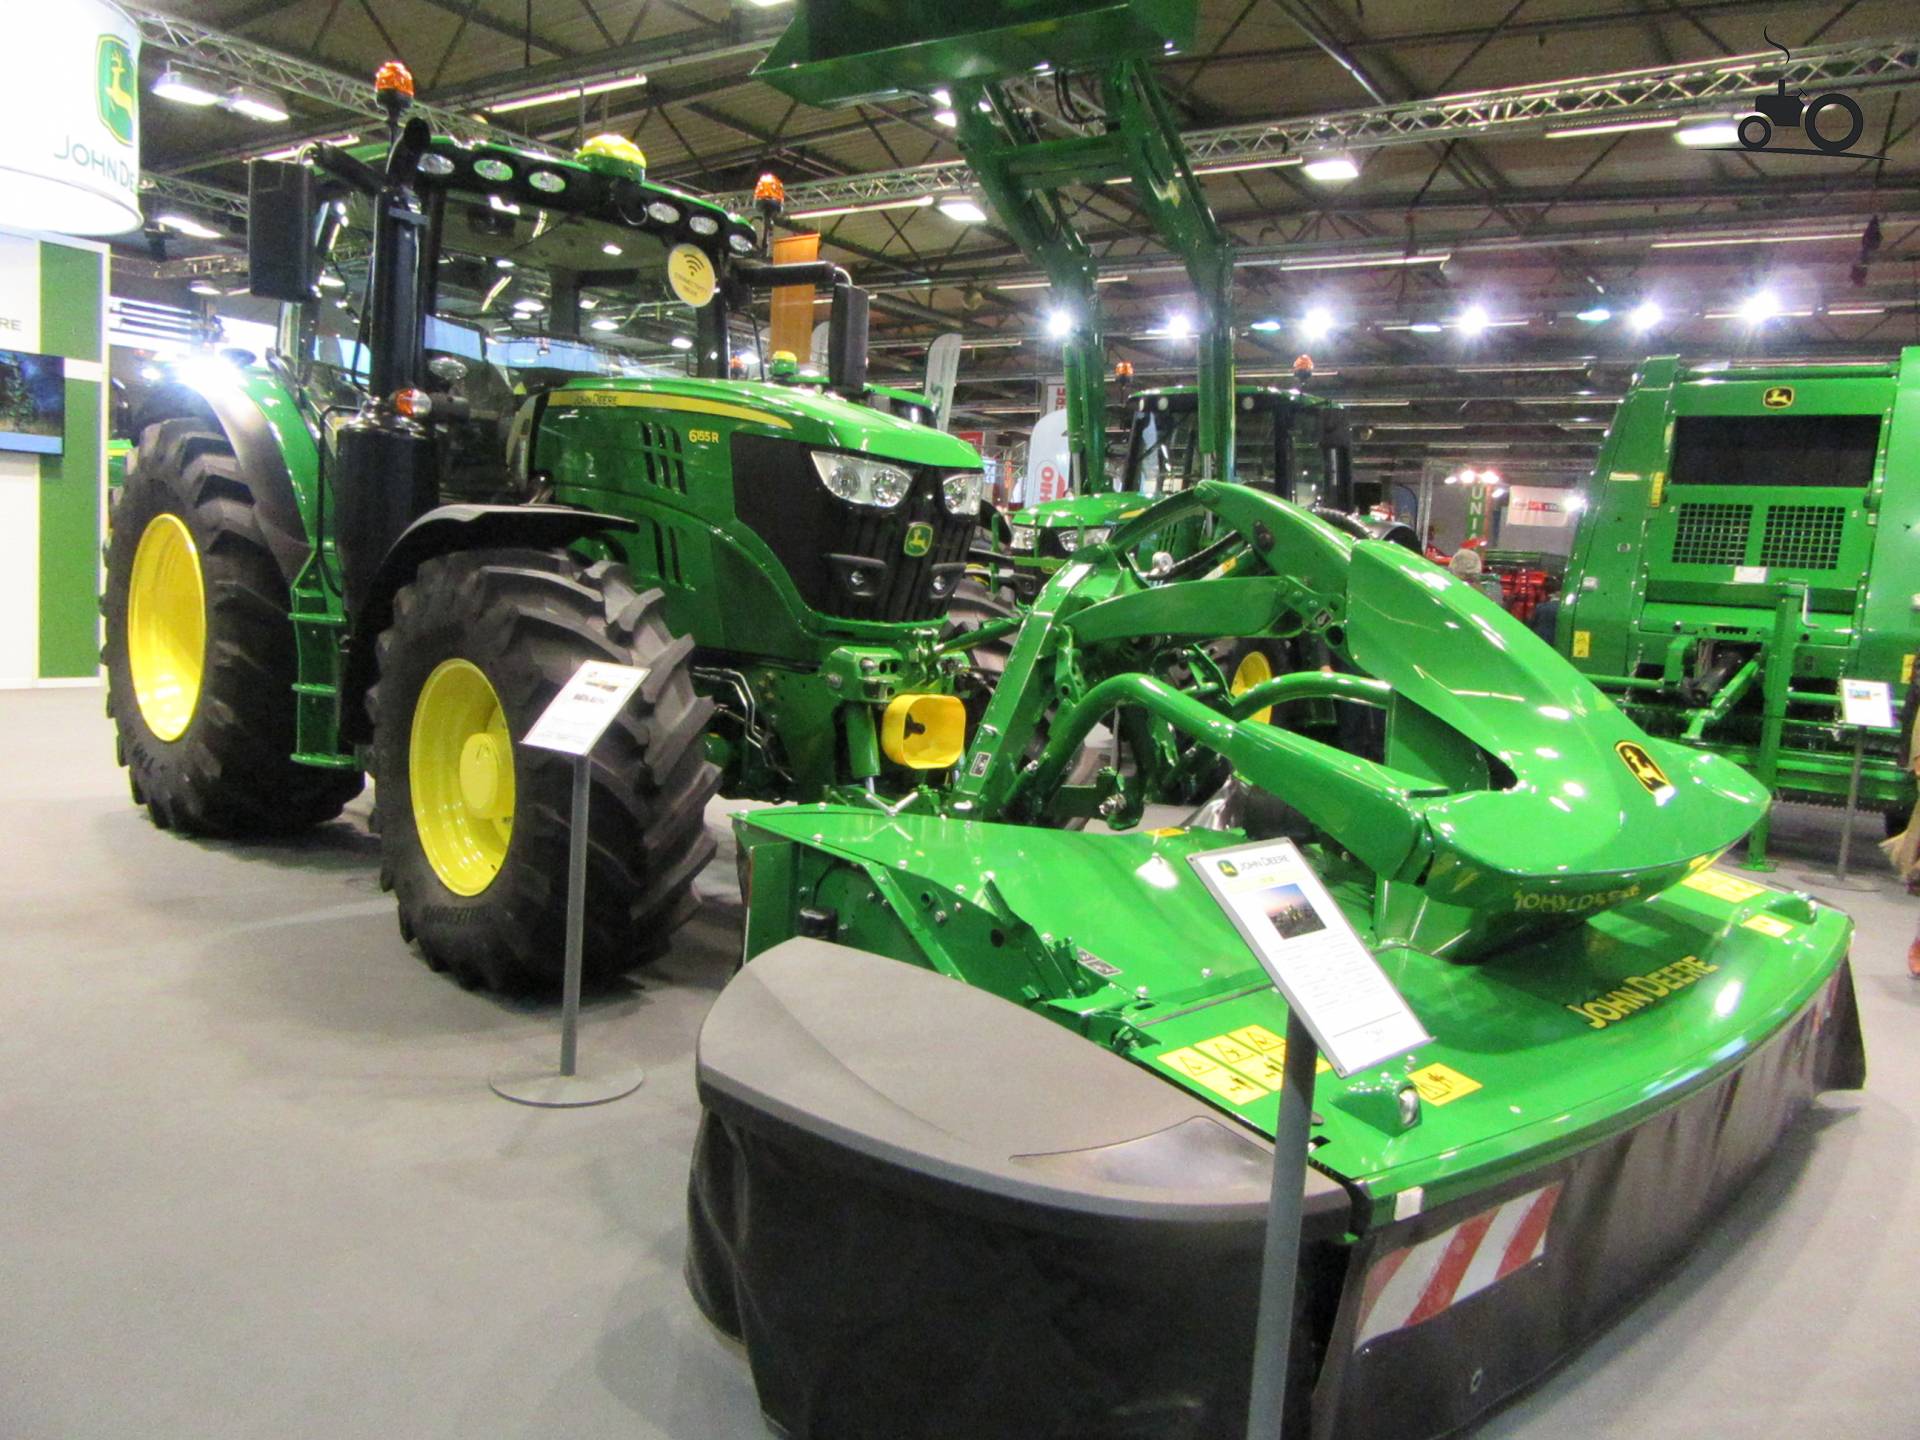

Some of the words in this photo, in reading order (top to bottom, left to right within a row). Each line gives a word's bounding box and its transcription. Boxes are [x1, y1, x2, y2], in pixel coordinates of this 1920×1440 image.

[54, 135, 118, 182] JOHN
[1566, 987, 1656, 1029] JOHN
[1623, 955, 1720, 998] DEERE
